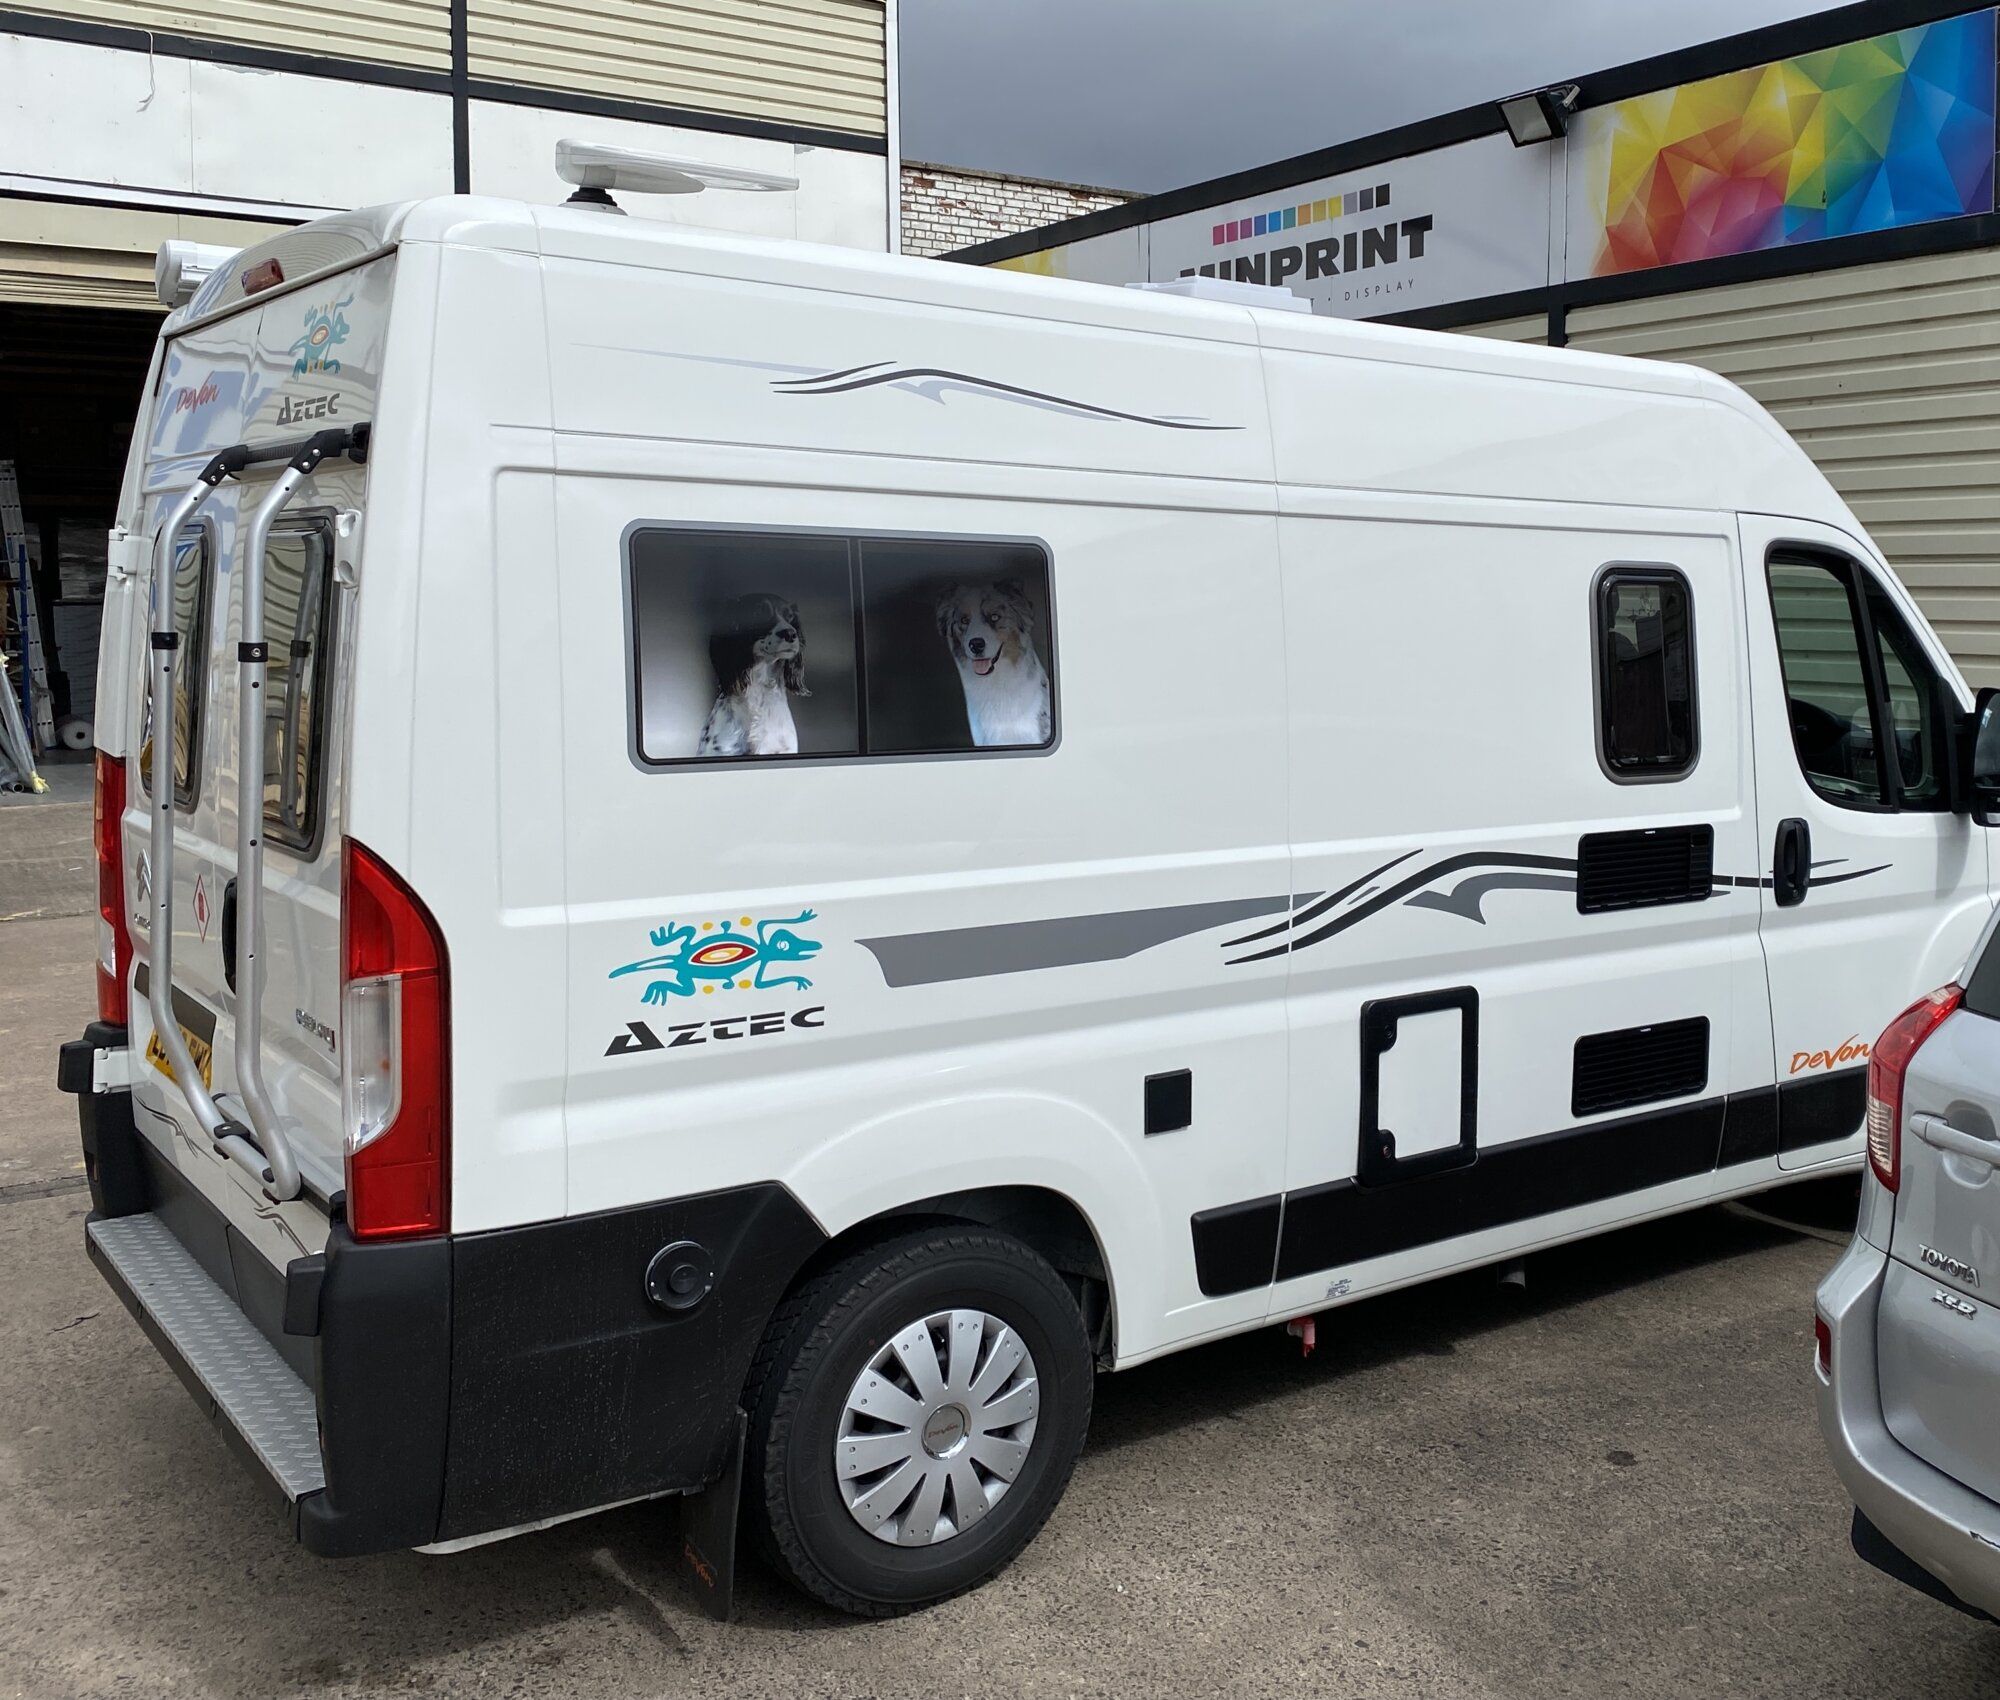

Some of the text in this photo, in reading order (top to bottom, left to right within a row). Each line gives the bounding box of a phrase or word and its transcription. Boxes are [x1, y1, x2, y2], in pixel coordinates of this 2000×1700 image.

[1180, 214, 1433, 288] INPRINT
[1344, 279, 1414, 302] DISPLAY
[603, 1005, 826, 1058] AZTEC
[1919, 1243, 1980, 1288] TOYOTA
